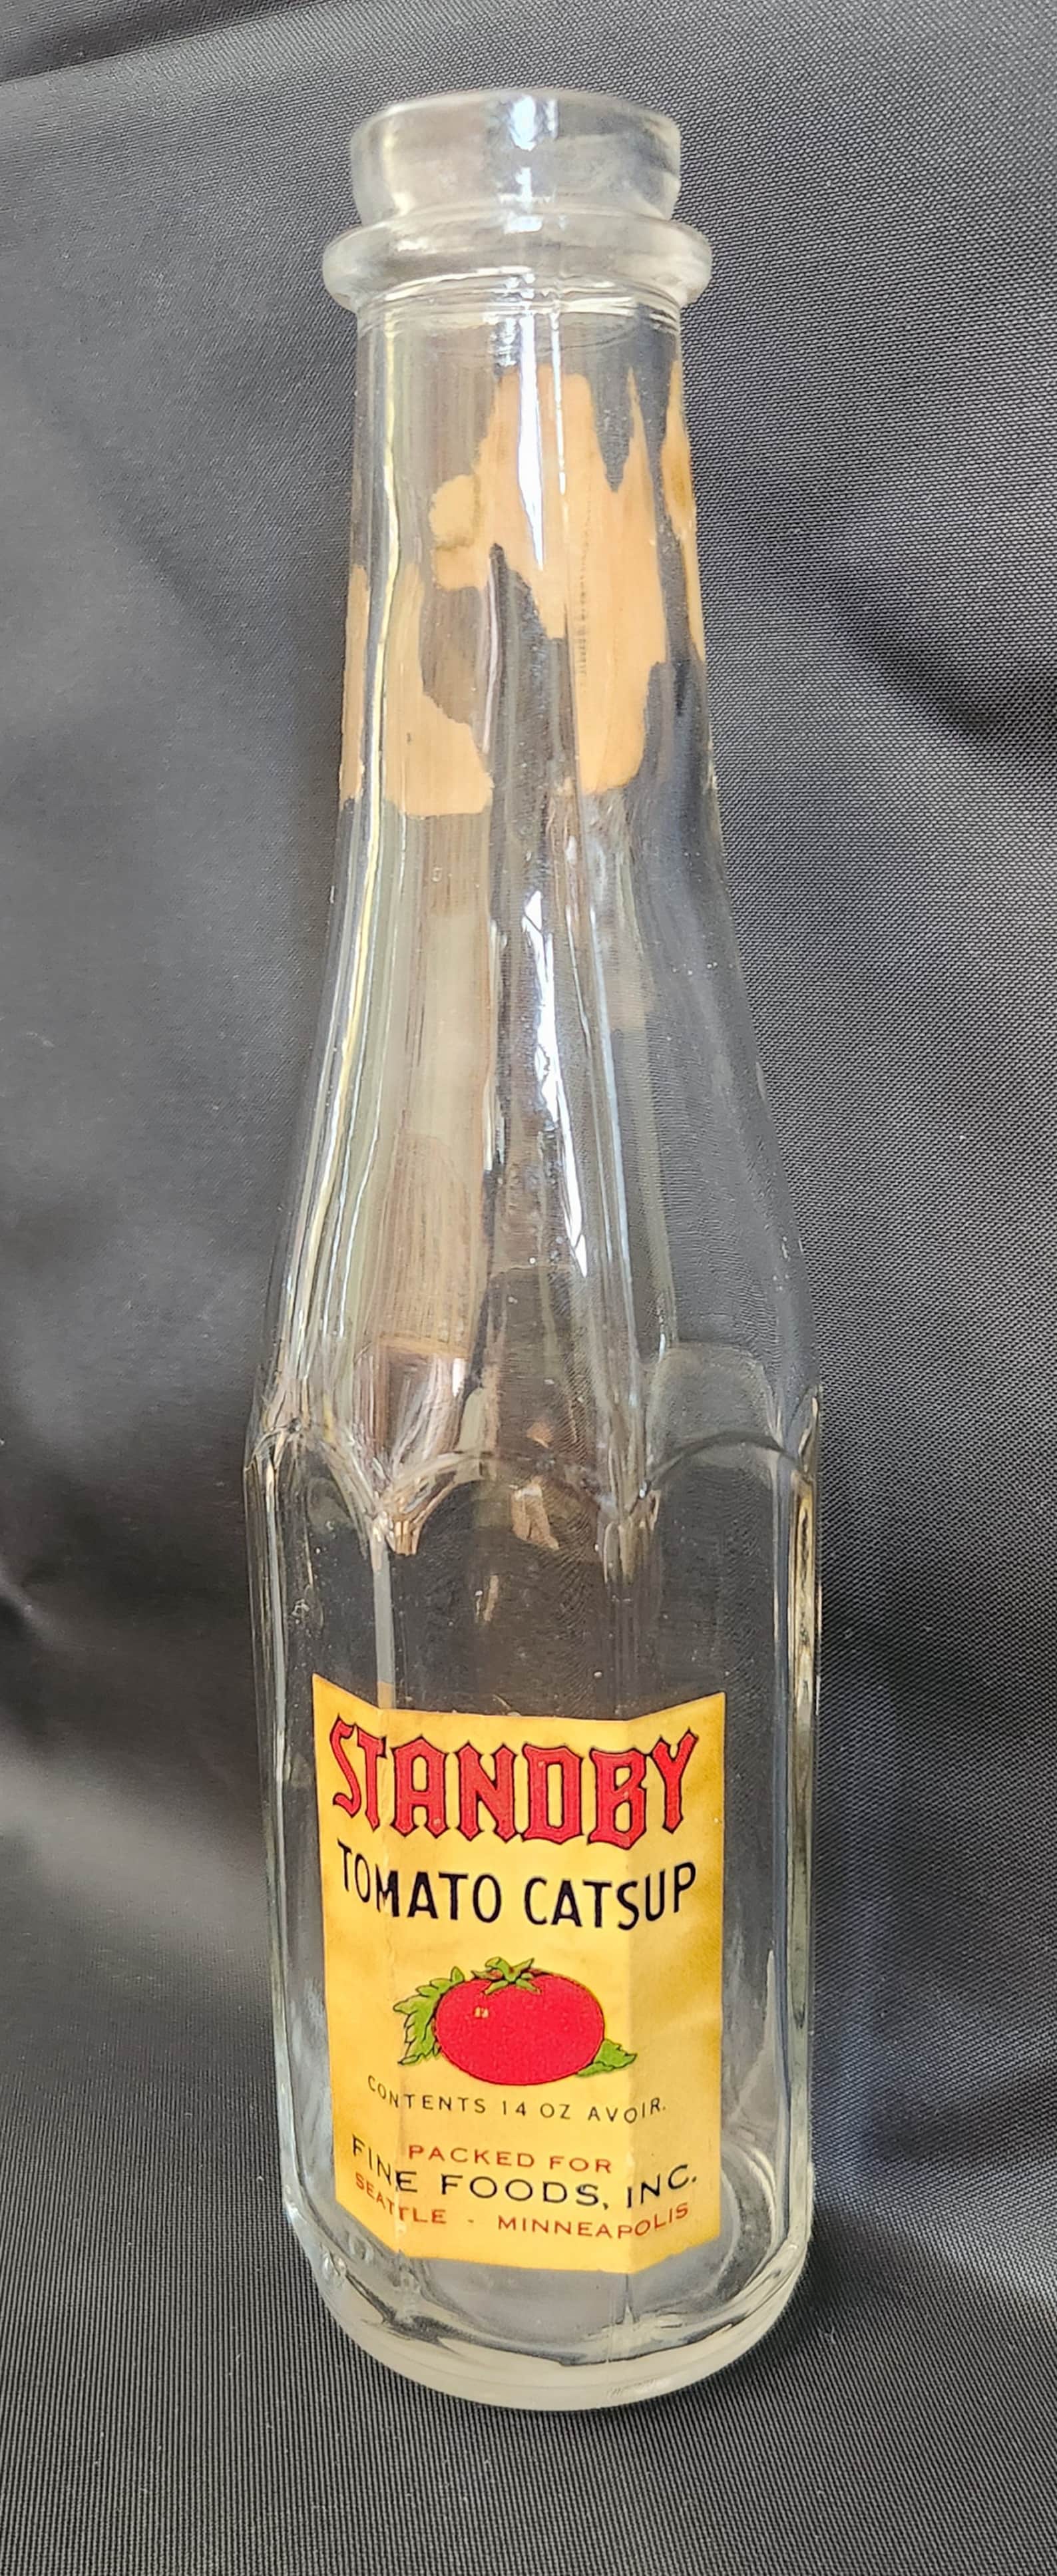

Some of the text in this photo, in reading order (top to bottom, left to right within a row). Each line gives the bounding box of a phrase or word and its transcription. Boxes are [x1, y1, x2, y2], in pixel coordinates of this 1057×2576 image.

[329, 1715, 699, 1850] STANDBY
[337, 1838, 697, 1931] TOMATO CATSUP
[367, 2075, 666, 2124] CONTENTS 14 OZ AVOIR.
[351, 2133, 698, 2210] FINE FOODS, INC.
[408, 2144, 612, 2173] PACKED FOR
[354, 2171, 447, 2225] SEATTLE
[497, 2202, 690, 2239] MINNEAPOLIS
